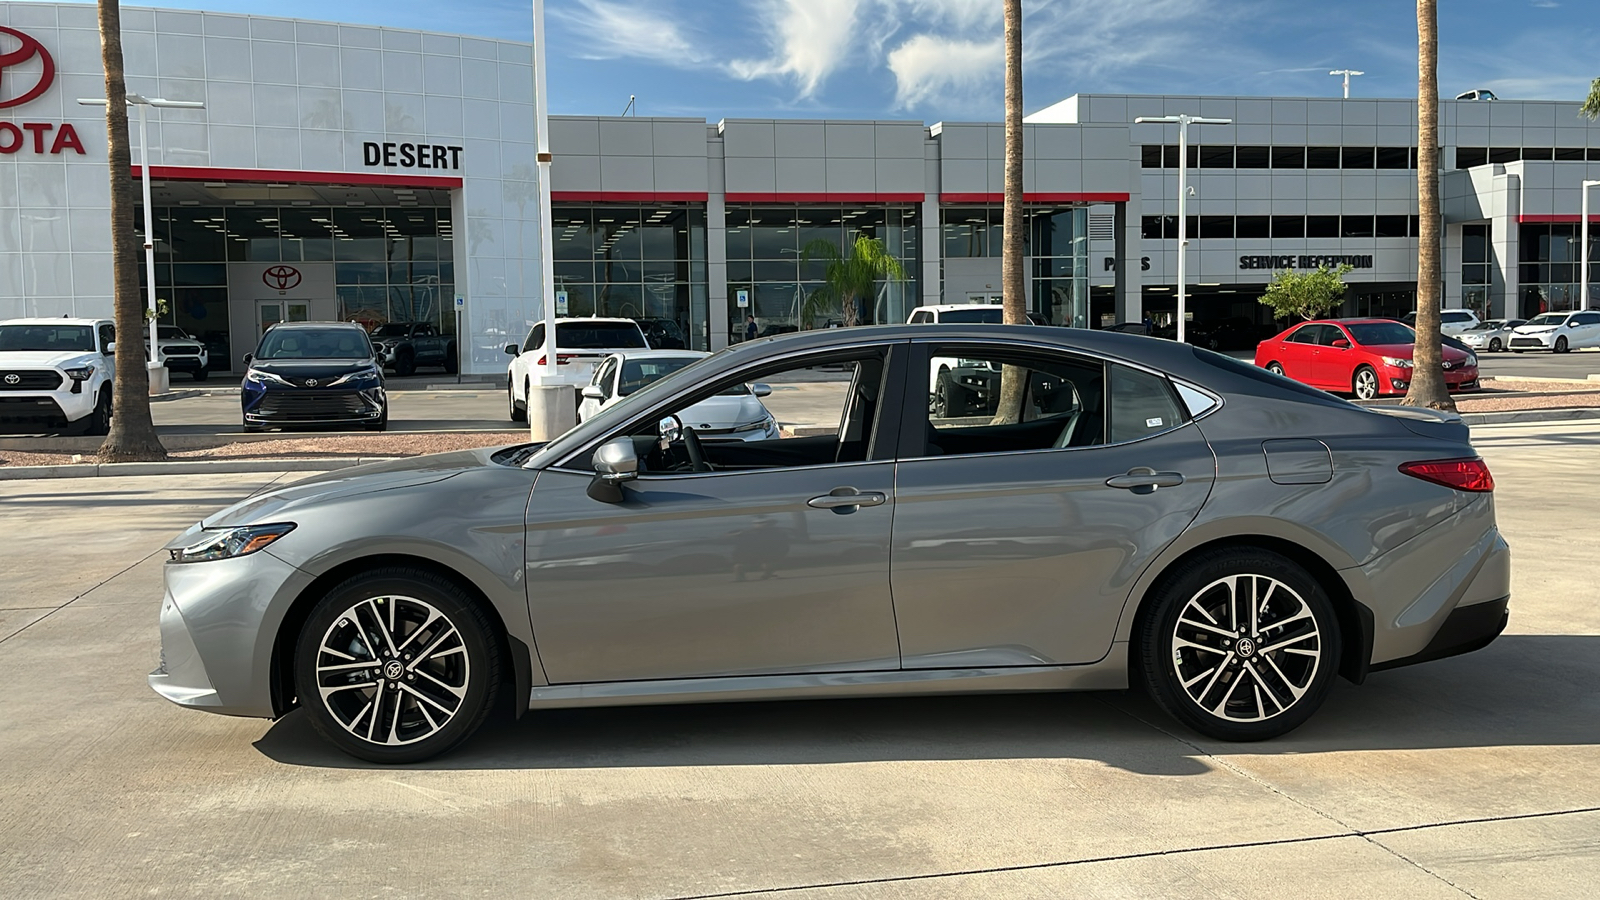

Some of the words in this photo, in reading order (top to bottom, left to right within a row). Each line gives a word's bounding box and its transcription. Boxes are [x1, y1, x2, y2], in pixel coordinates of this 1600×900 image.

[363, 142, 463, 169] DESERT
[1239, 255, 1296, 269] SERVICE
[1298, 255, 1373, 269] RECEPTION
